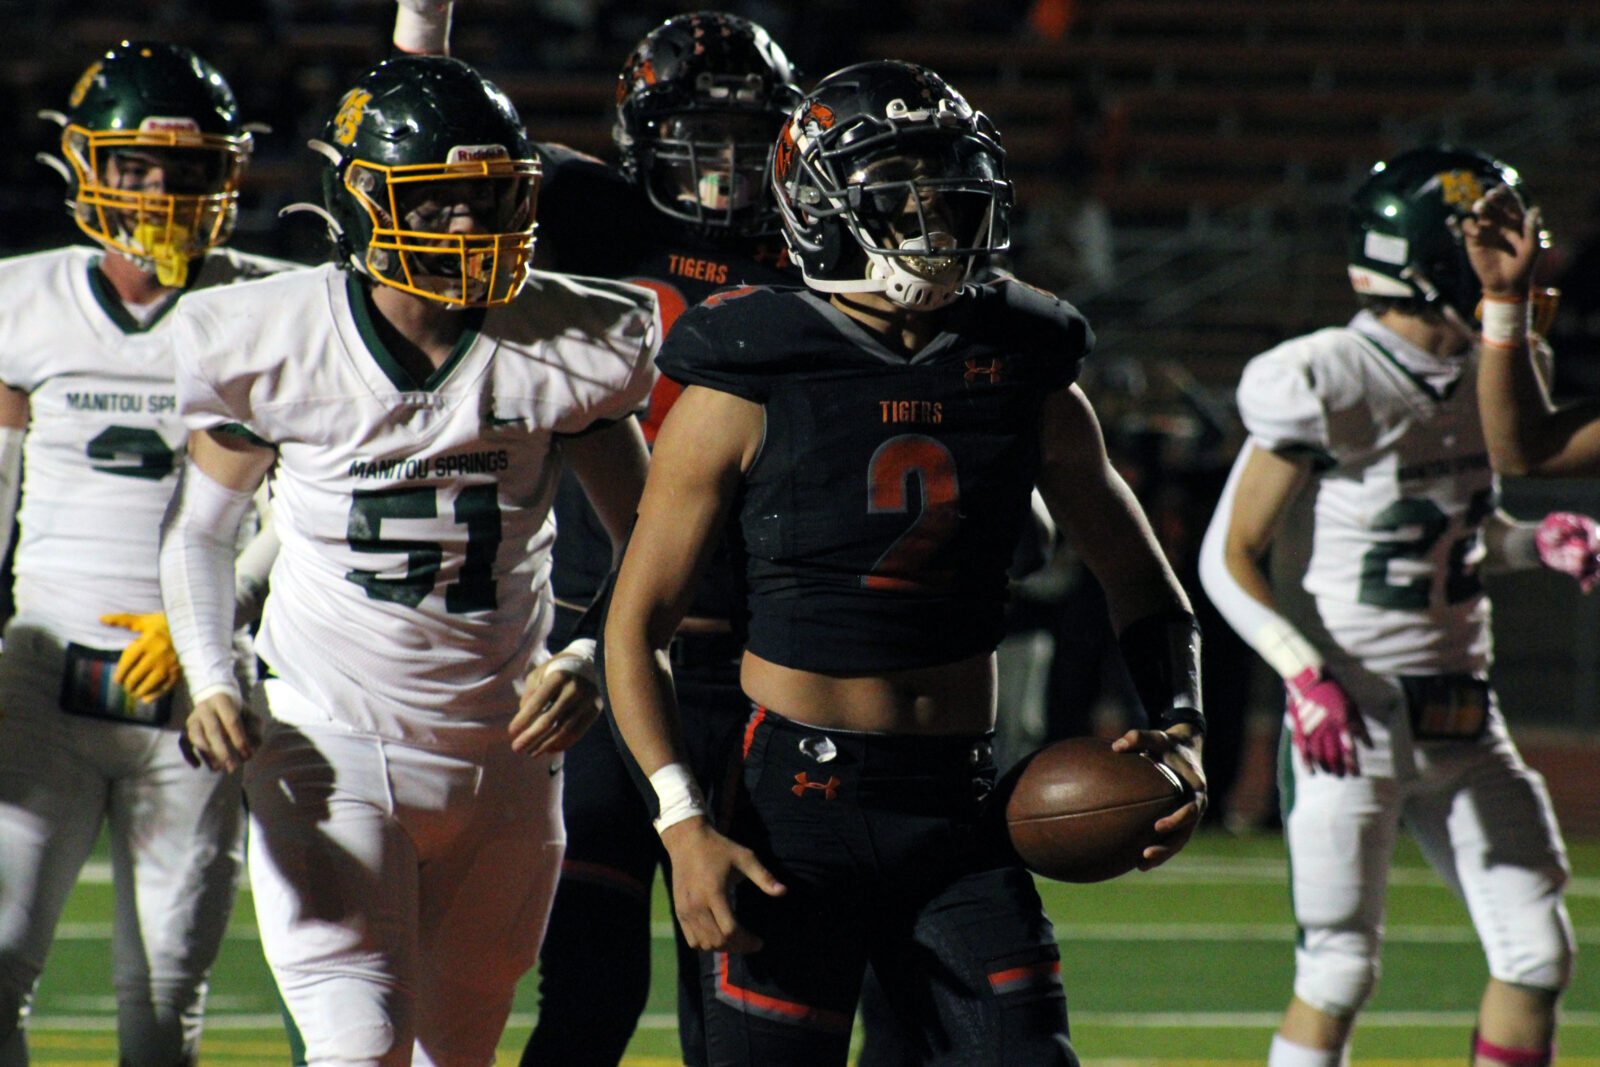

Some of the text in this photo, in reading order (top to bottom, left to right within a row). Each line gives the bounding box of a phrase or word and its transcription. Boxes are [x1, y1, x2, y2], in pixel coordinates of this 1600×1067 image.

[669, 254, 728, 284] TIGERS
[66, 392, 142, 412] MANITOU
[879, 400, 943, 424] TIGERS
[349, 450, 508, 480] MANITOU SPRINGS
[861, 433, 961, 592] 2
[344, 484, 502, 614] 51
